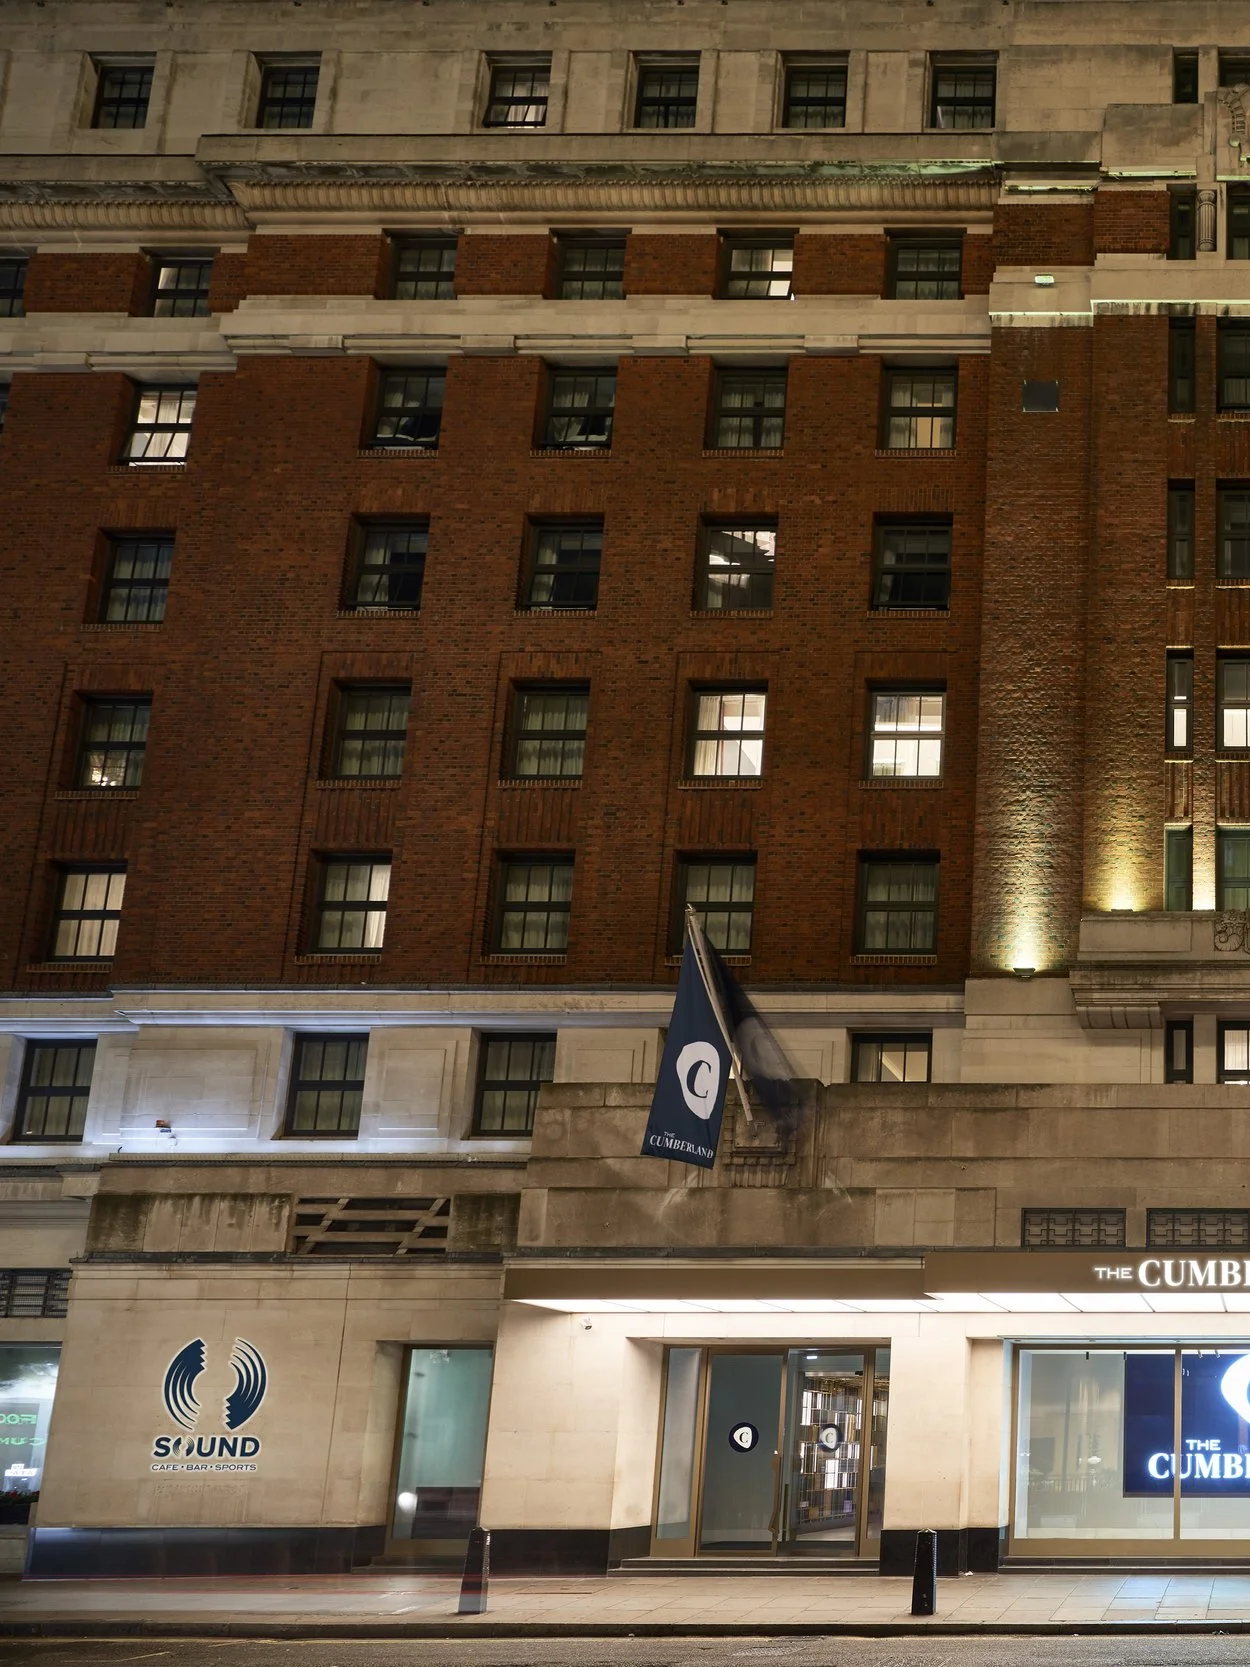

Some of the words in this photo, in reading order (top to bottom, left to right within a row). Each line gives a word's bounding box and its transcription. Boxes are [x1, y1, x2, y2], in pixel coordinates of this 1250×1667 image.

[686, 1060, 711, 1098] C
[650, 1135, 713, 1158] CUMBERLAND
[1095, 1267, 1132, 1280] THE
[739, 1432, 748, 1443] C
[1186, 1439, 1221, 1451] THE
[153, 1436, 260, 1458] SOUND
